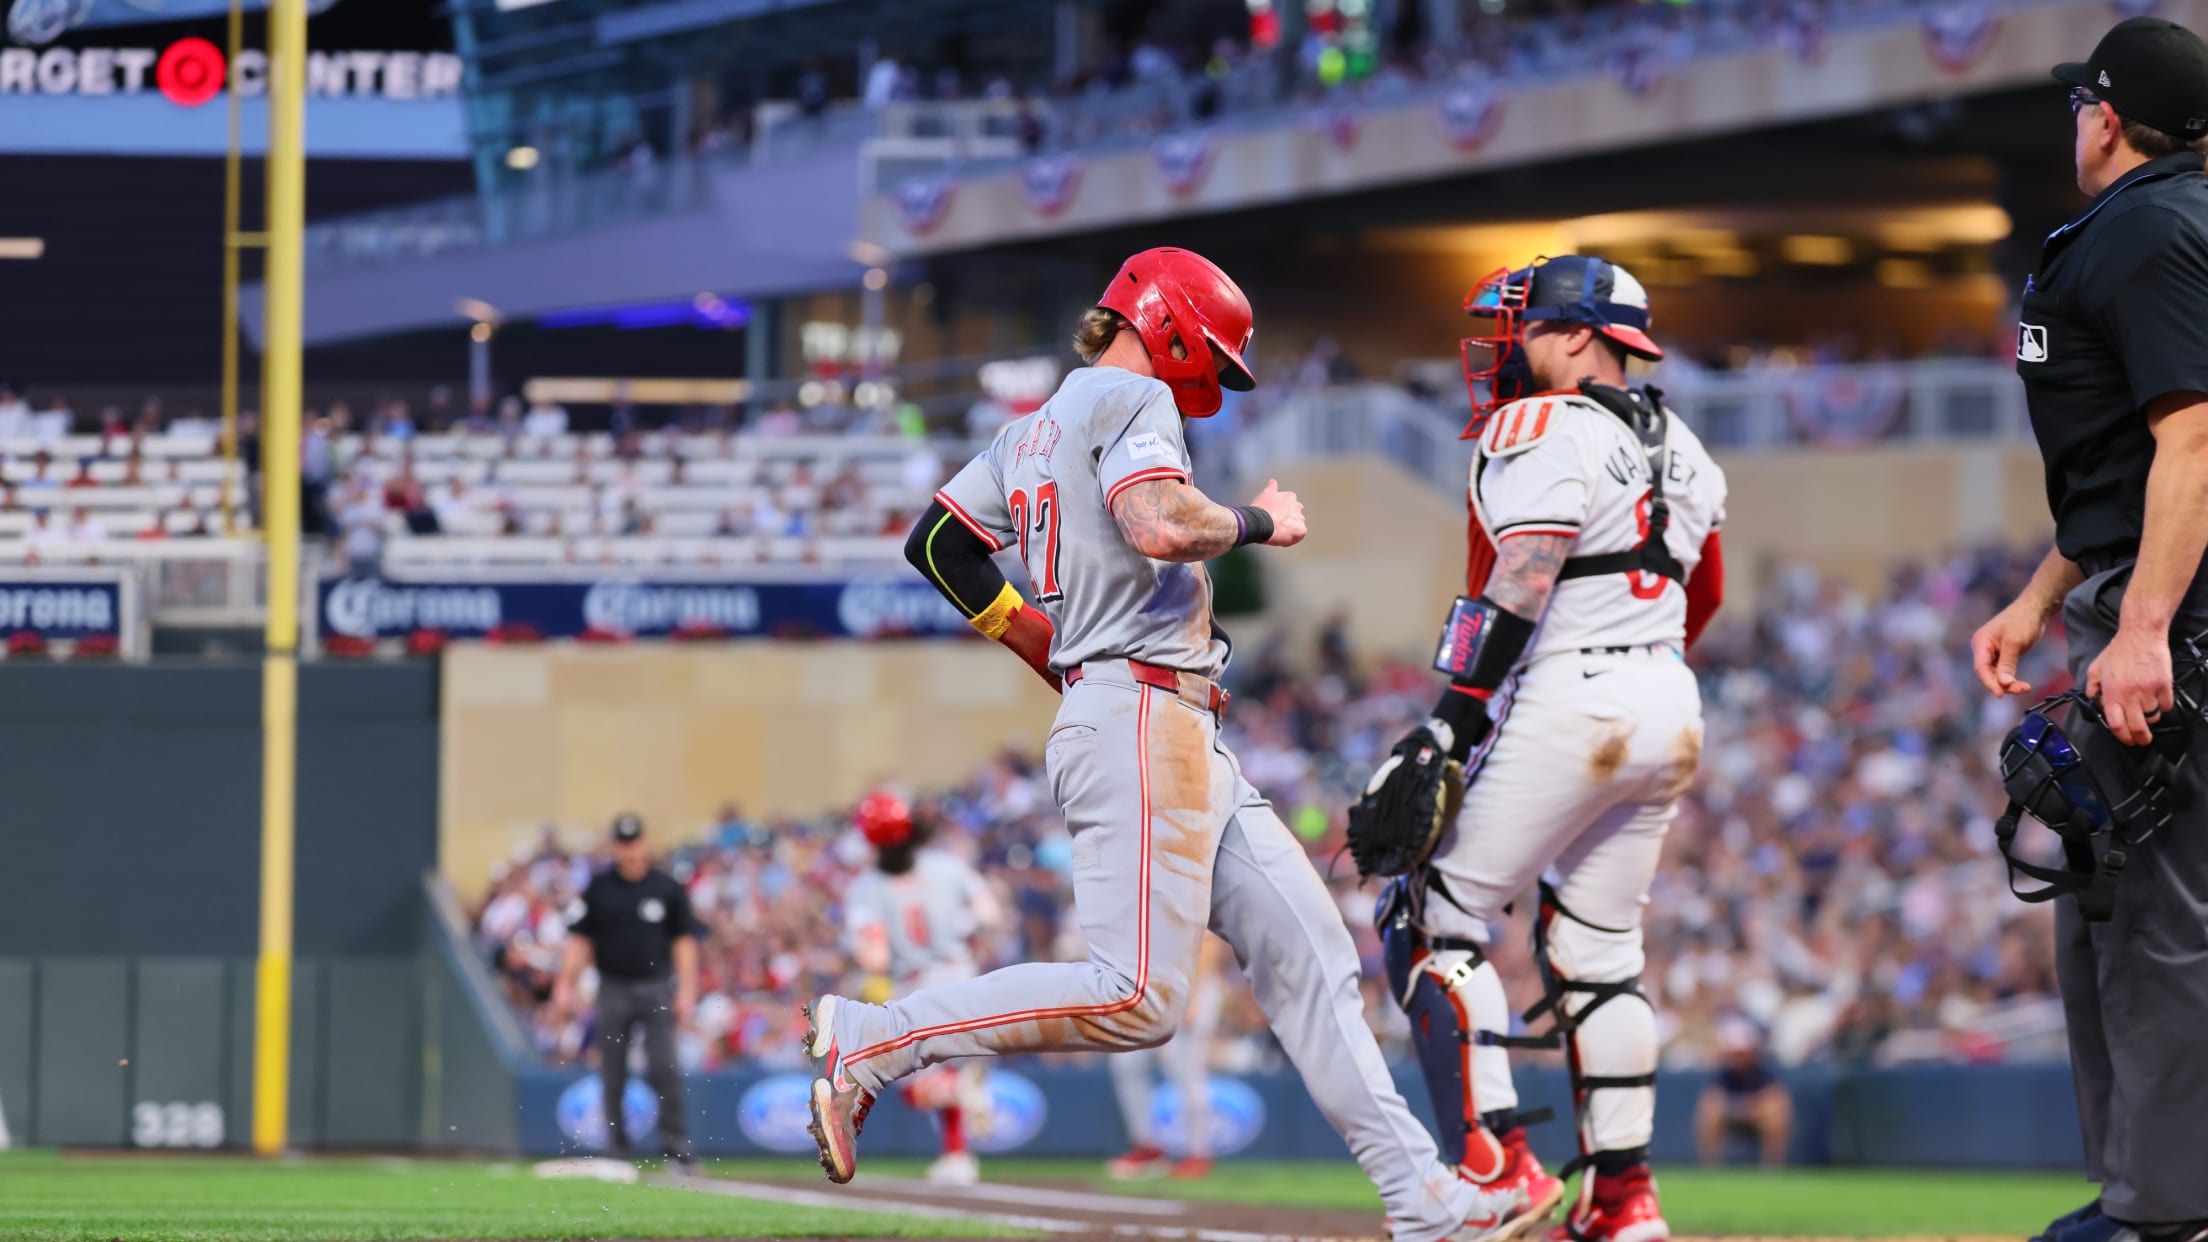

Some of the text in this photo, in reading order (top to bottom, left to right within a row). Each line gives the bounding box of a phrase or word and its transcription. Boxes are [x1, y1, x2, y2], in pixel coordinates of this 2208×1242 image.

[229, 49, 464, 98] CNTER
[1009, 480, 1064, 603] 27
[326, 578, 502, 637] Corona
[1451, 612, 1483, 672] Twins
[132, 1101, 225, 1148] 328
